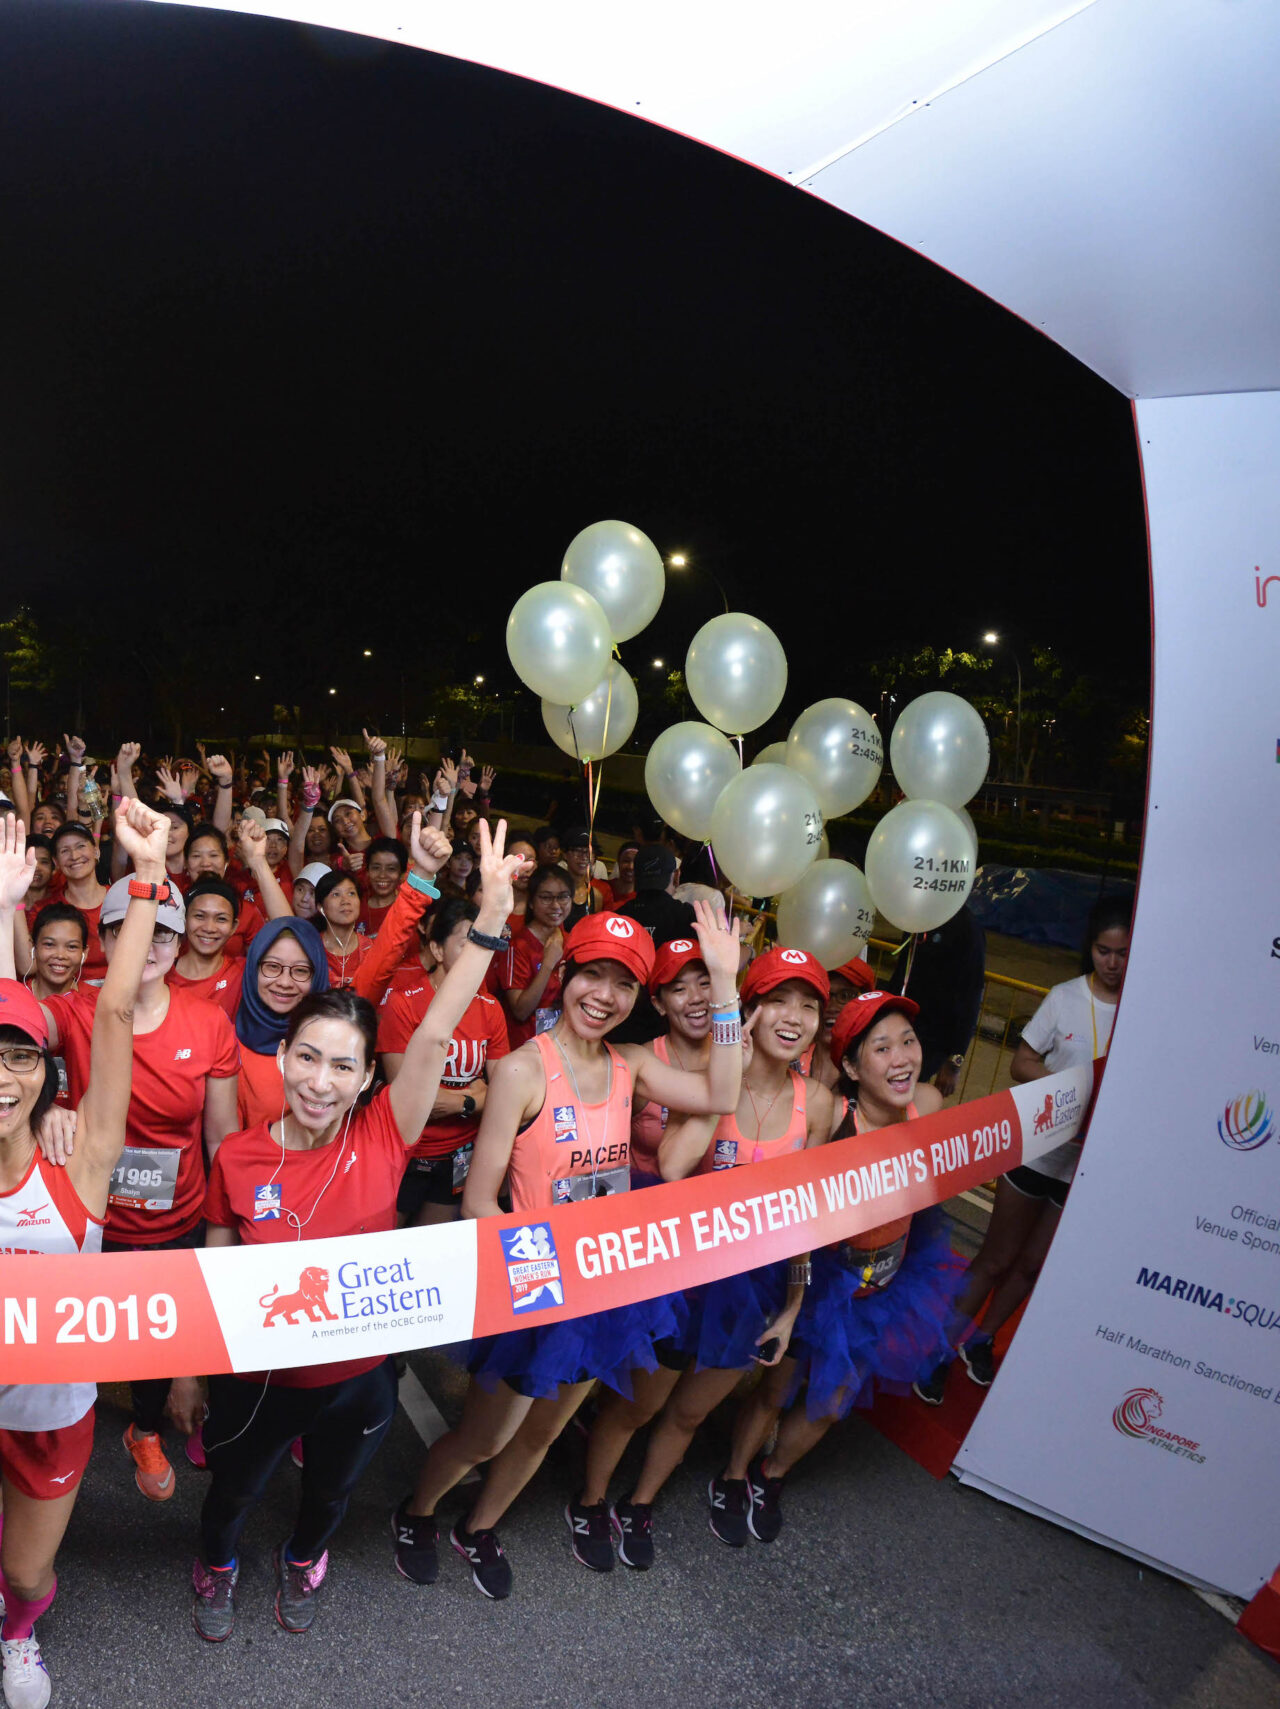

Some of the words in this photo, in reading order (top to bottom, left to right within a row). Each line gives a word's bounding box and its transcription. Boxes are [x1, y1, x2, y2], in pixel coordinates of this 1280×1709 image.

[914, 856, 969, 873] 21.1KM
[913, 877, 967, 892] 2:45HR
[1055, 1086, 1077, 1108] Great
[1055, 1104, 1081, 1127] Eastern
[570, 1143, 628, 1168] PACER
[575, 1216, 682, 1280] GREAT
[689, 1182, 818, 1252] EASTERN
[820, 1148, 928, 1213] WOMEN'S
[932, 1133, 969, 1178] RUN
[972, 1119, 1012, 1163] 2019
[1195, 1216, 1238, 1241] Venue
[337, 1258, 415, 1289] Great
[513, 1265, 529, 1275] GREAT
[531, 1261, 555, 1272] EASTERN
[540, 1269, 551, 1277] RUN
[515, 1283, 528, 1293] 2019
[341, 1286, 442, 1319] Eastern
[55, 1293, 178, 1344] 2019
[311, 1330, 318, 1338] A
[321, 1325, 359, 1338] member
[361, 1321, 371, 1333] of
[373, 1319, 389, 1331] the
[390, 1316, 415, 1328] OCBC
[417, 1313, 444, 1326] Group
[1096, 1325, 1126, 1345] Half
[1126, 1336, 1192, 1371] Marathon
[1194, 1362, 1272, 1400] Sanctioned
[1148, 1436, 1207, 1465] ATHLETICS
